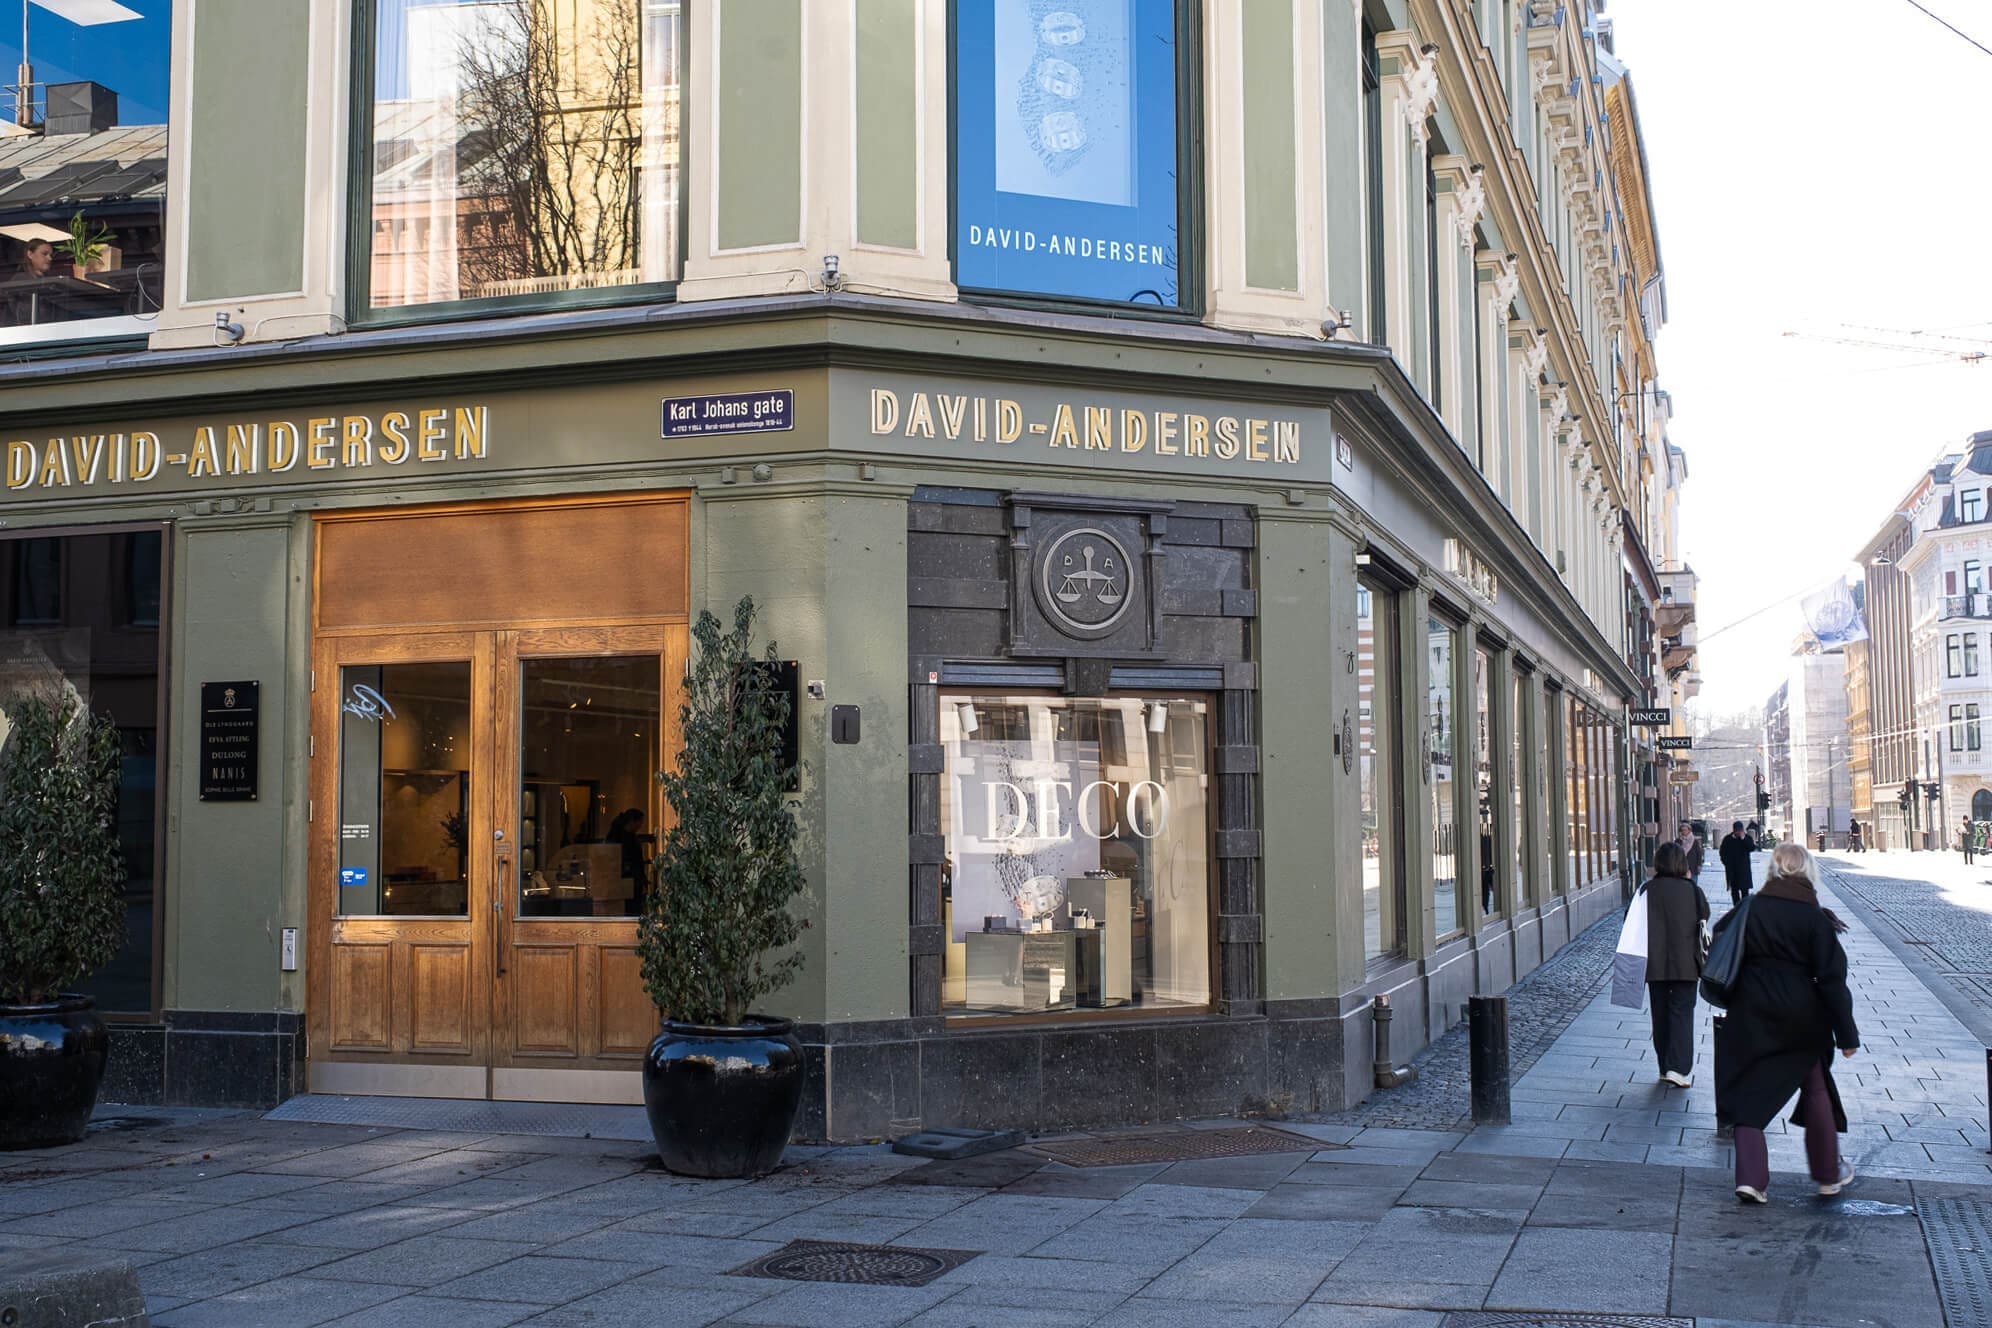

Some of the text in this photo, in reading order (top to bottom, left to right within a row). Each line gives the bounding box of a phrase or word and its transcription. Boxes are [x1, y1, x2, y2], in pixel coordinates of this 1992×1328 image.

[970, 225, 1163, 265] DAVID-ANDERSEN
[670, 396, 784, 420] Karl Johans gate
[871, 388, 1300, 464] DAVID-ANDERSEN
[6, 406, 488, 489] DAVID-ANDERSEN
[1064, 555, 1114, 569] D A
[1629, 712, 1667, 721] VINCCI
[1661, 739, 1690, 747] VINCCI
[211, 751, 247, 759] DULONG
[212, 767, 246, 779] NANIS
[981, 780, 1171, 842] DECO
